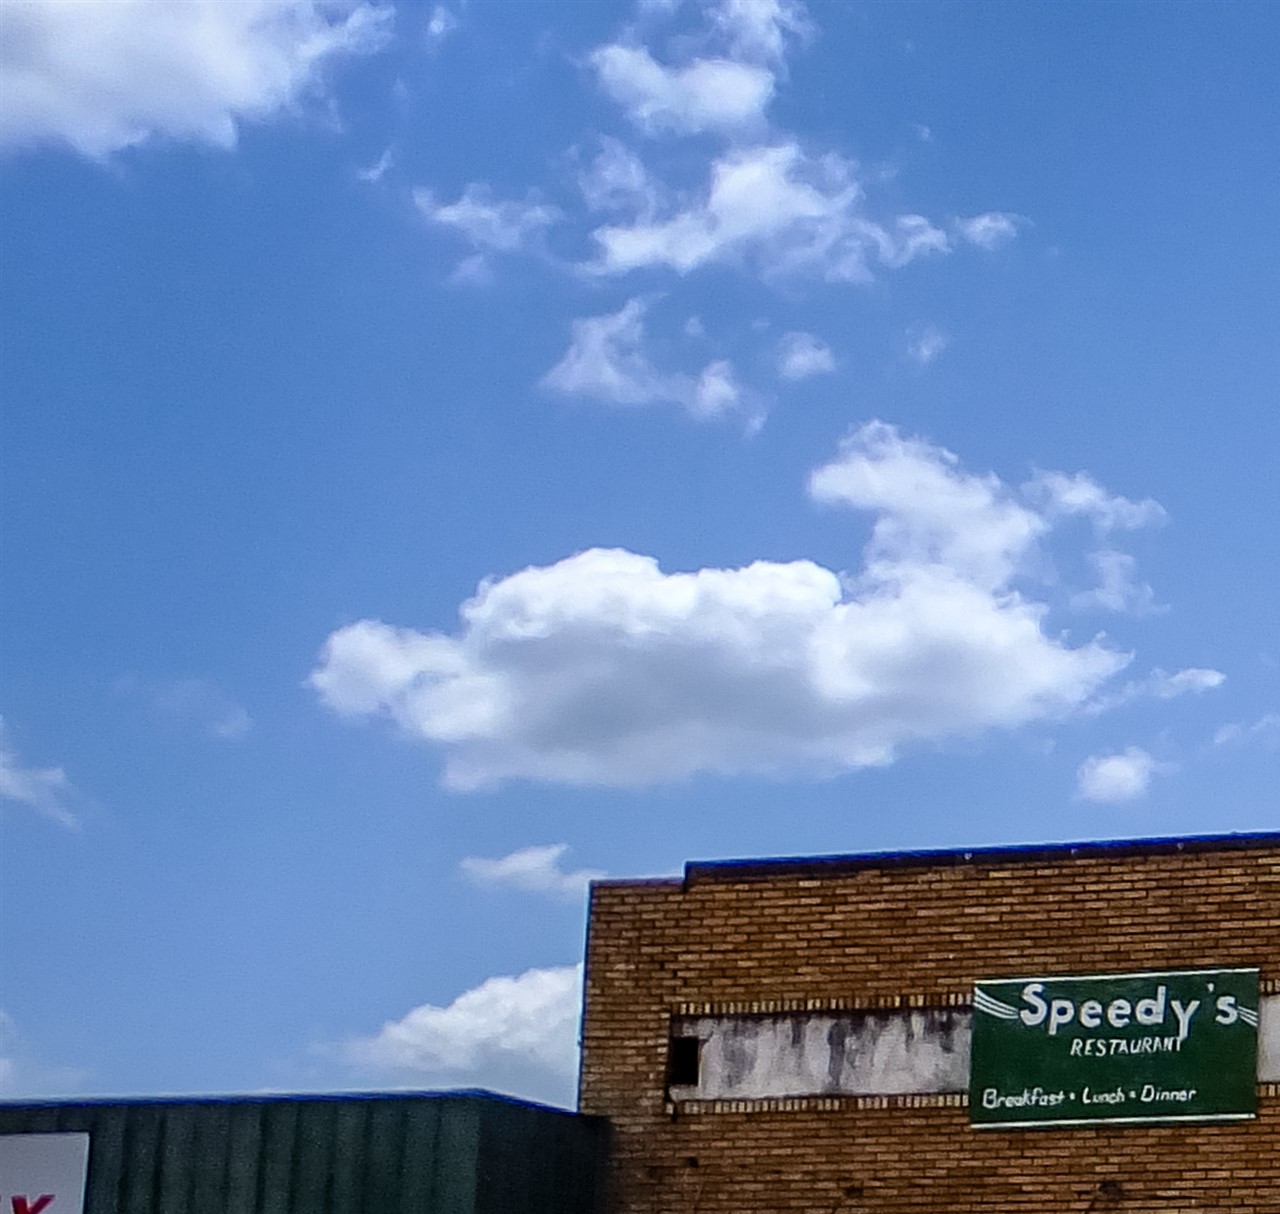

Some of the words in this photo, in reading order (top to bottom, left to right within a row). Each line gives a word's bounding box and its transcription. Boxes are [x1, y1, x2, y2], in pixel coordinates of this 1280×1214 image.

[1019, 983, 1240, 1040] Speedy's
[1070, 1035, 1183, 1057] RESTAURANT
[982, 1088, 1065, 1109] Breakfast
[1082, 1086, 1126, 1104] Lunch
[1140, 1084, 1197, 1103] Dinner
